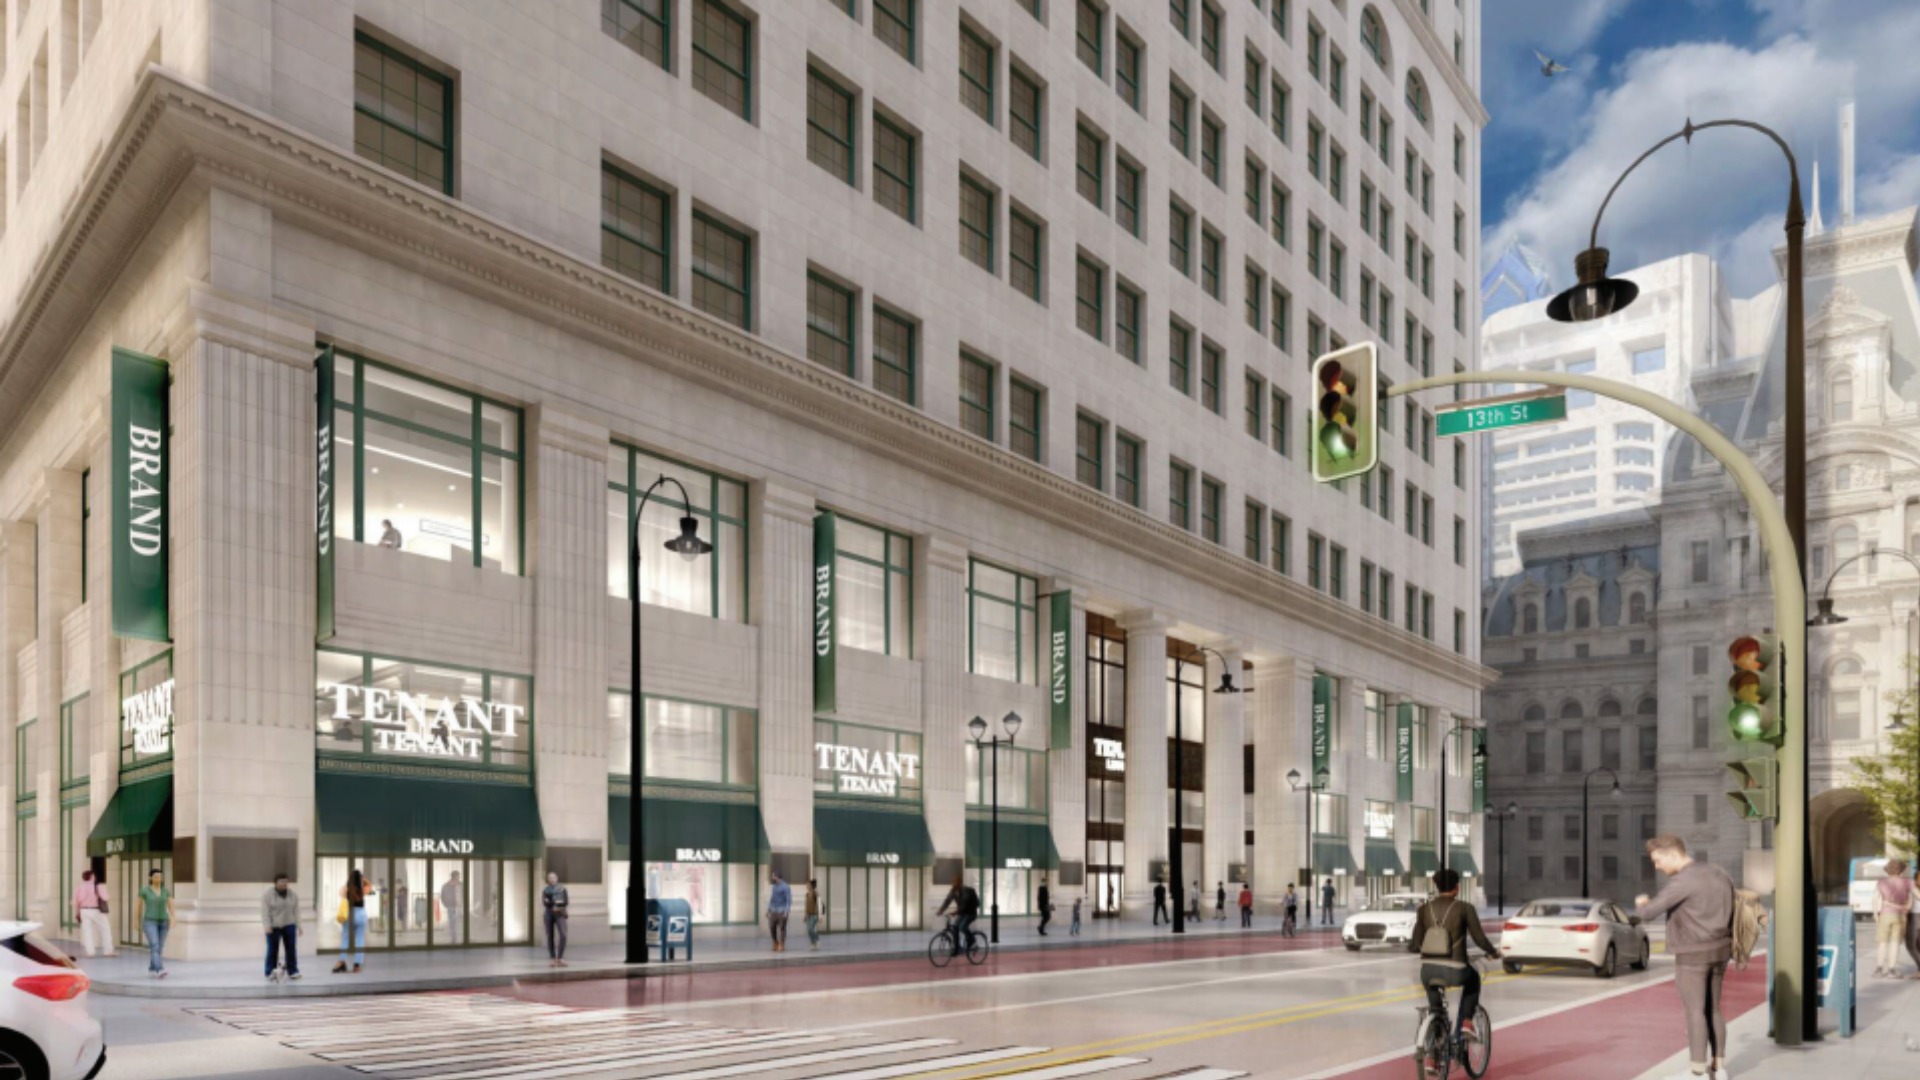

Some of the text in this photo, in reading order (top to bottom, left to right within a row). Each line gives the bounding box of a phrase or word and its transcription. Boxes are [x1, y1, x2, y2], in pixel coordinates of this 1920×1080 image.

[1467, 405, 1528, 428] 13th St
[130, 422, 161, 556] BRAND
[318, 424, 330, 555] BRAND
[816, 564, 830, 657] BRAND
[1053, 630, 1066, 704] BRAND
[322, 681, 525, 738] TENANT
[1314, 703, 1325, 757] BRAND
[374, 729, 483, 758] TENANT
[815, 741, 920, 779] TENANT
[1399, 727, 1409, 774] BRAND
[840, 774, 897, 795] TENANT
[410, 838, 475, 853] BRAND
[676, 847, 722, 862] BRAND
[866, 852, 900, 864] BRAND
